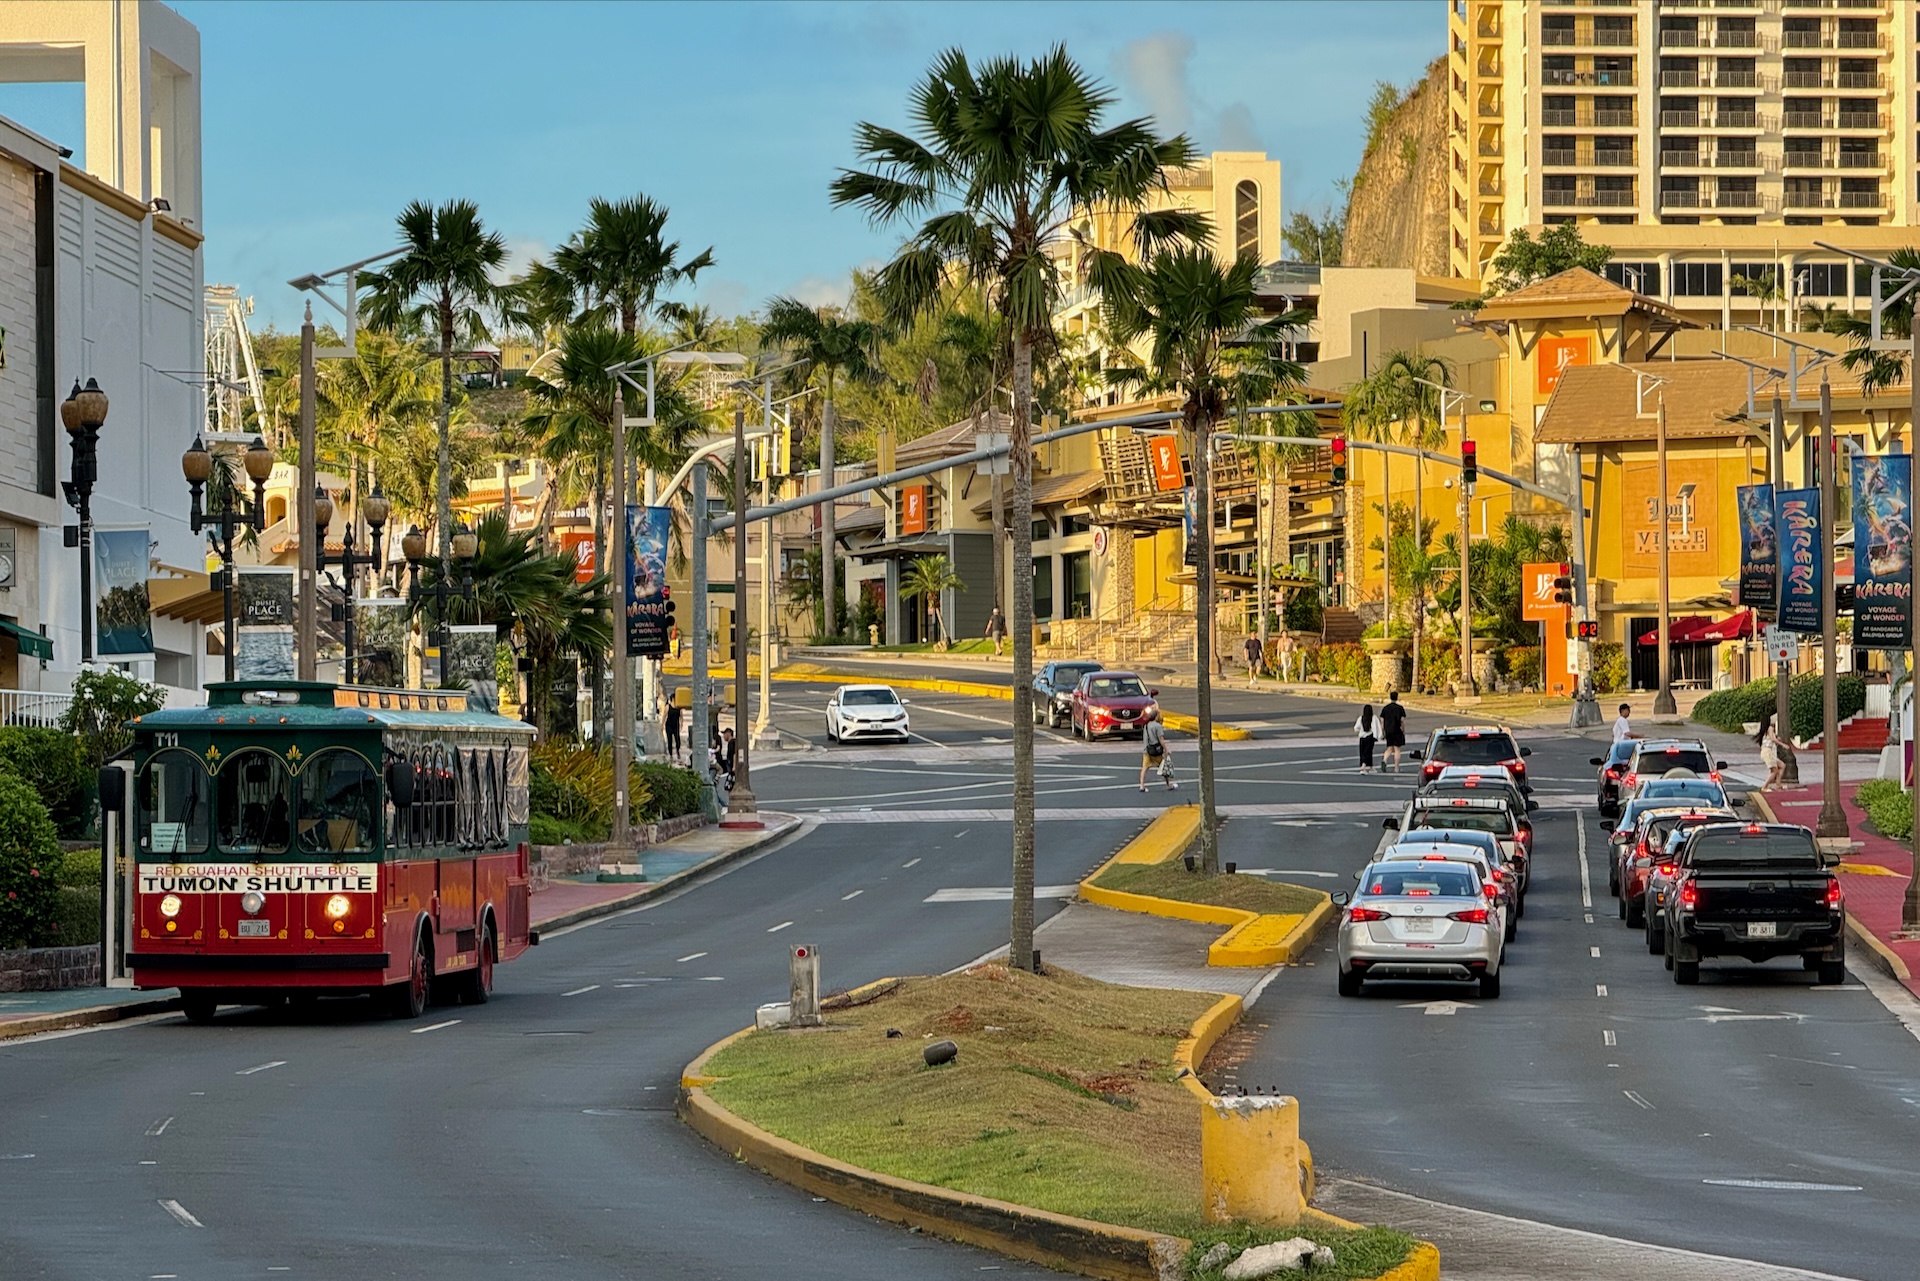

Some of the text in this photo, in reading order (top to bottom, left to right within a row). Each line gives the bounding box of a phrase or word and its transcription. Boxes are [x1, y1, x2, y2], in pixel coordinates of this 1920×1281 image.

[105, 567, 138, 578] PLACE
[248, 605, 283, 616] PLACE
[1867, 606, 1897, 614] VOYAGE
[365, 634, 395, 643] PLACE
[460, 659, 489, 667] PLACE
[155, 732, 179, 747] T11
[156, 865, 360, 876] RED GUAHAN SHUTTLE BUS
[143, 876, 372, 892] TUMON SHUTTLE
